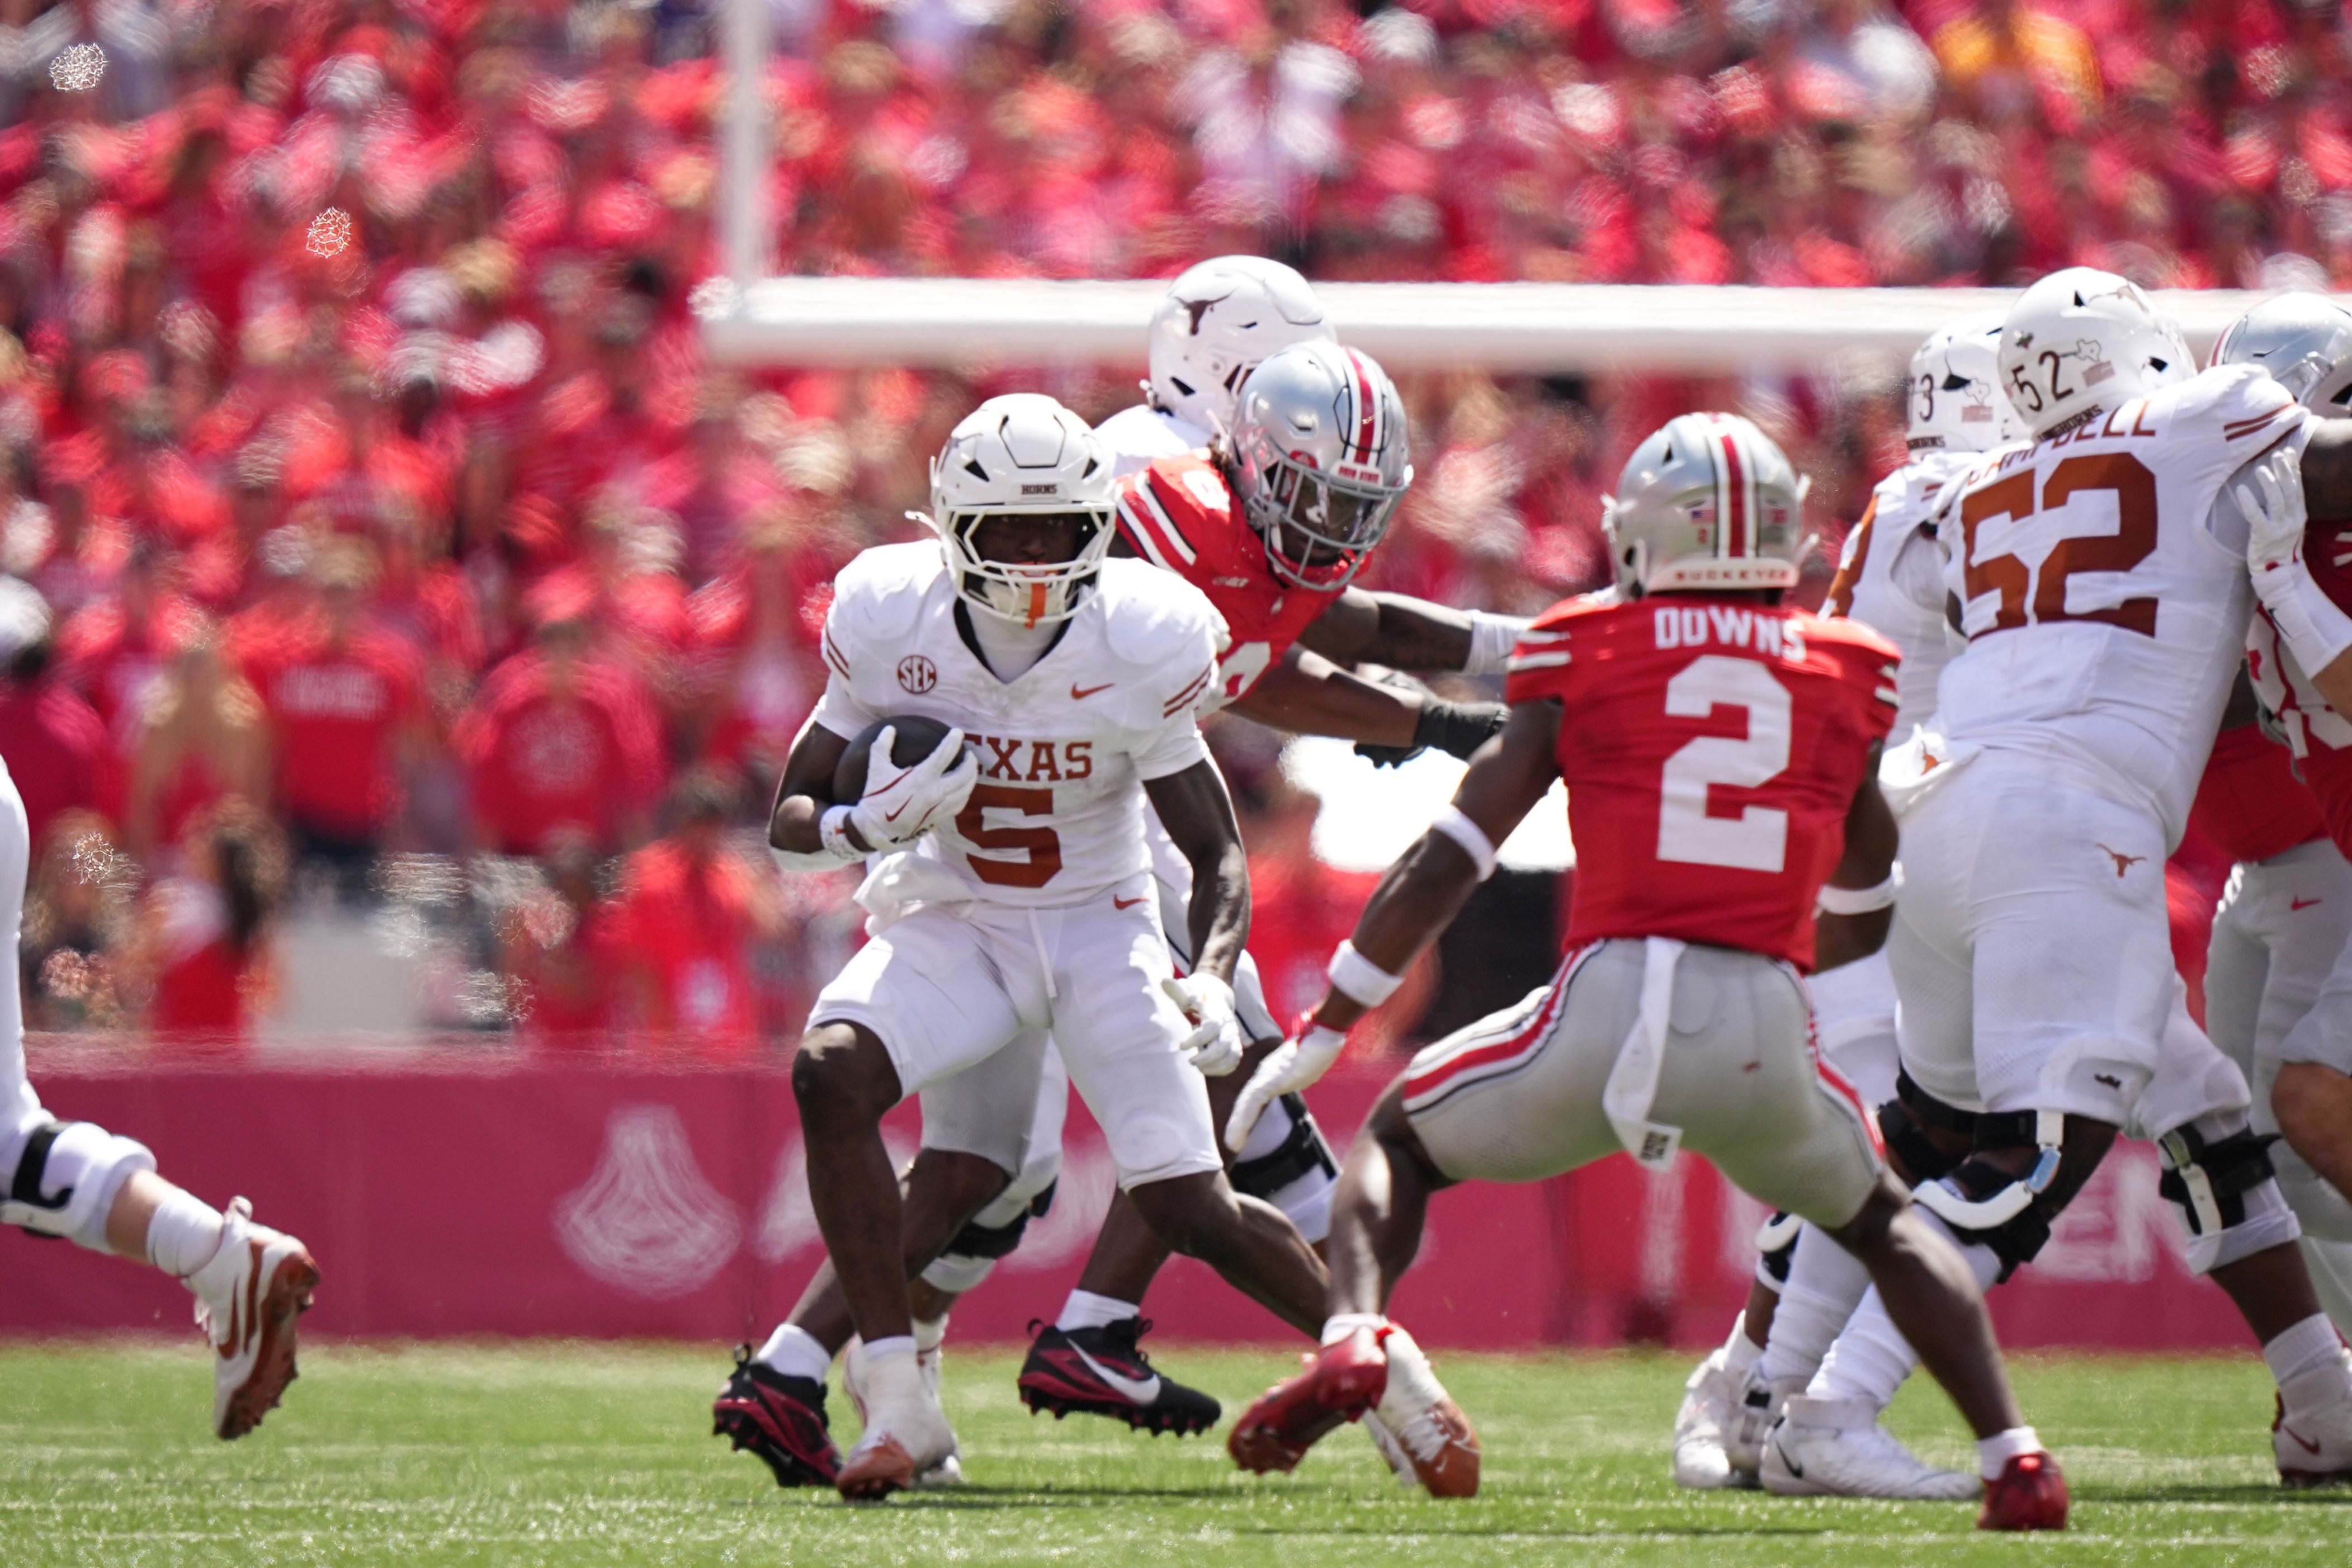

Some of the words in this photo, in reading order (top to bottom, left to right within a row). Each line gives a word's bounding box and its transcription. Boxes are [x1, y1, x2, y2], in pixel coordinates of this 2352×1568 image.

[2011, 350, 2074, 413] 52
[1021, 484, 1057, 495] HORNS
[1961, 451, 2159, 642] 52
[1654, 604, 1807, 662] DOWNS
[898, 655, 937, 694] SEC
[1656, 654, 1792, 873] 2
[955, 783, 1062, 888] 5
